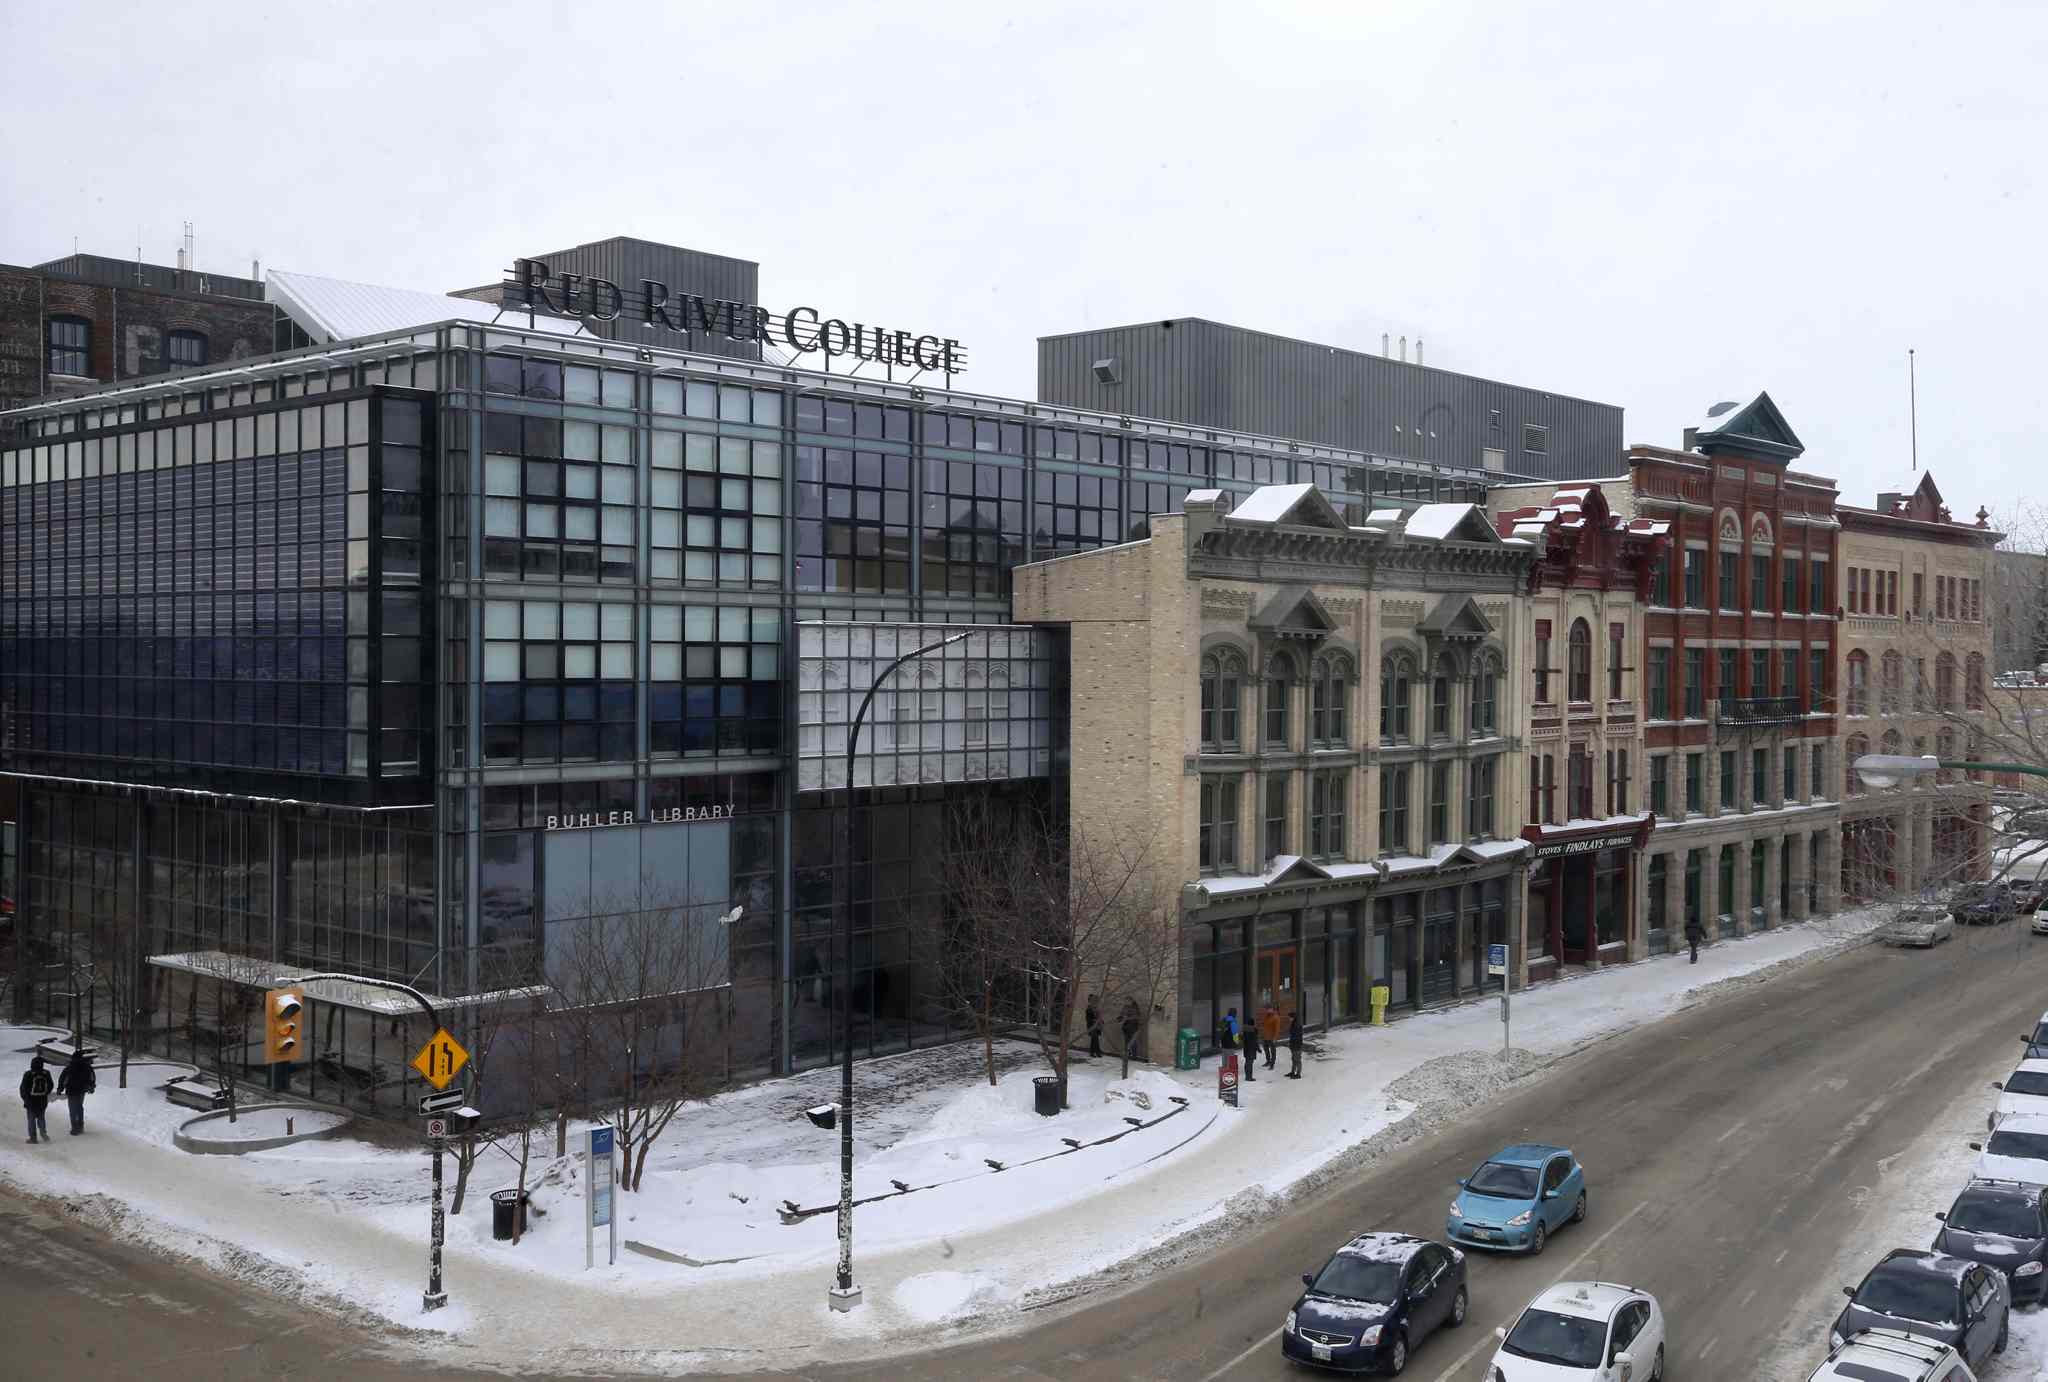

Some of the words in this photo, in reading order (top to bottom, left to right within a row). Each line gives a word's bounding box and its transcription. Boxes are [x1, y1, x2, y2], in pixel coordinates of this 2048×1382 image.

[518, 258, 624, 321] RED
[640, 279, 778, 346] RIVER
[784, 306, 960, 374] COLLEGE
[547, 811, 634, 829] BUHLER
[651, 804, 735, 823] LIBRARY
[1537, 845, 1561, 856] STOVES
[1565, 839, 1605, 854] FINDLAYS
